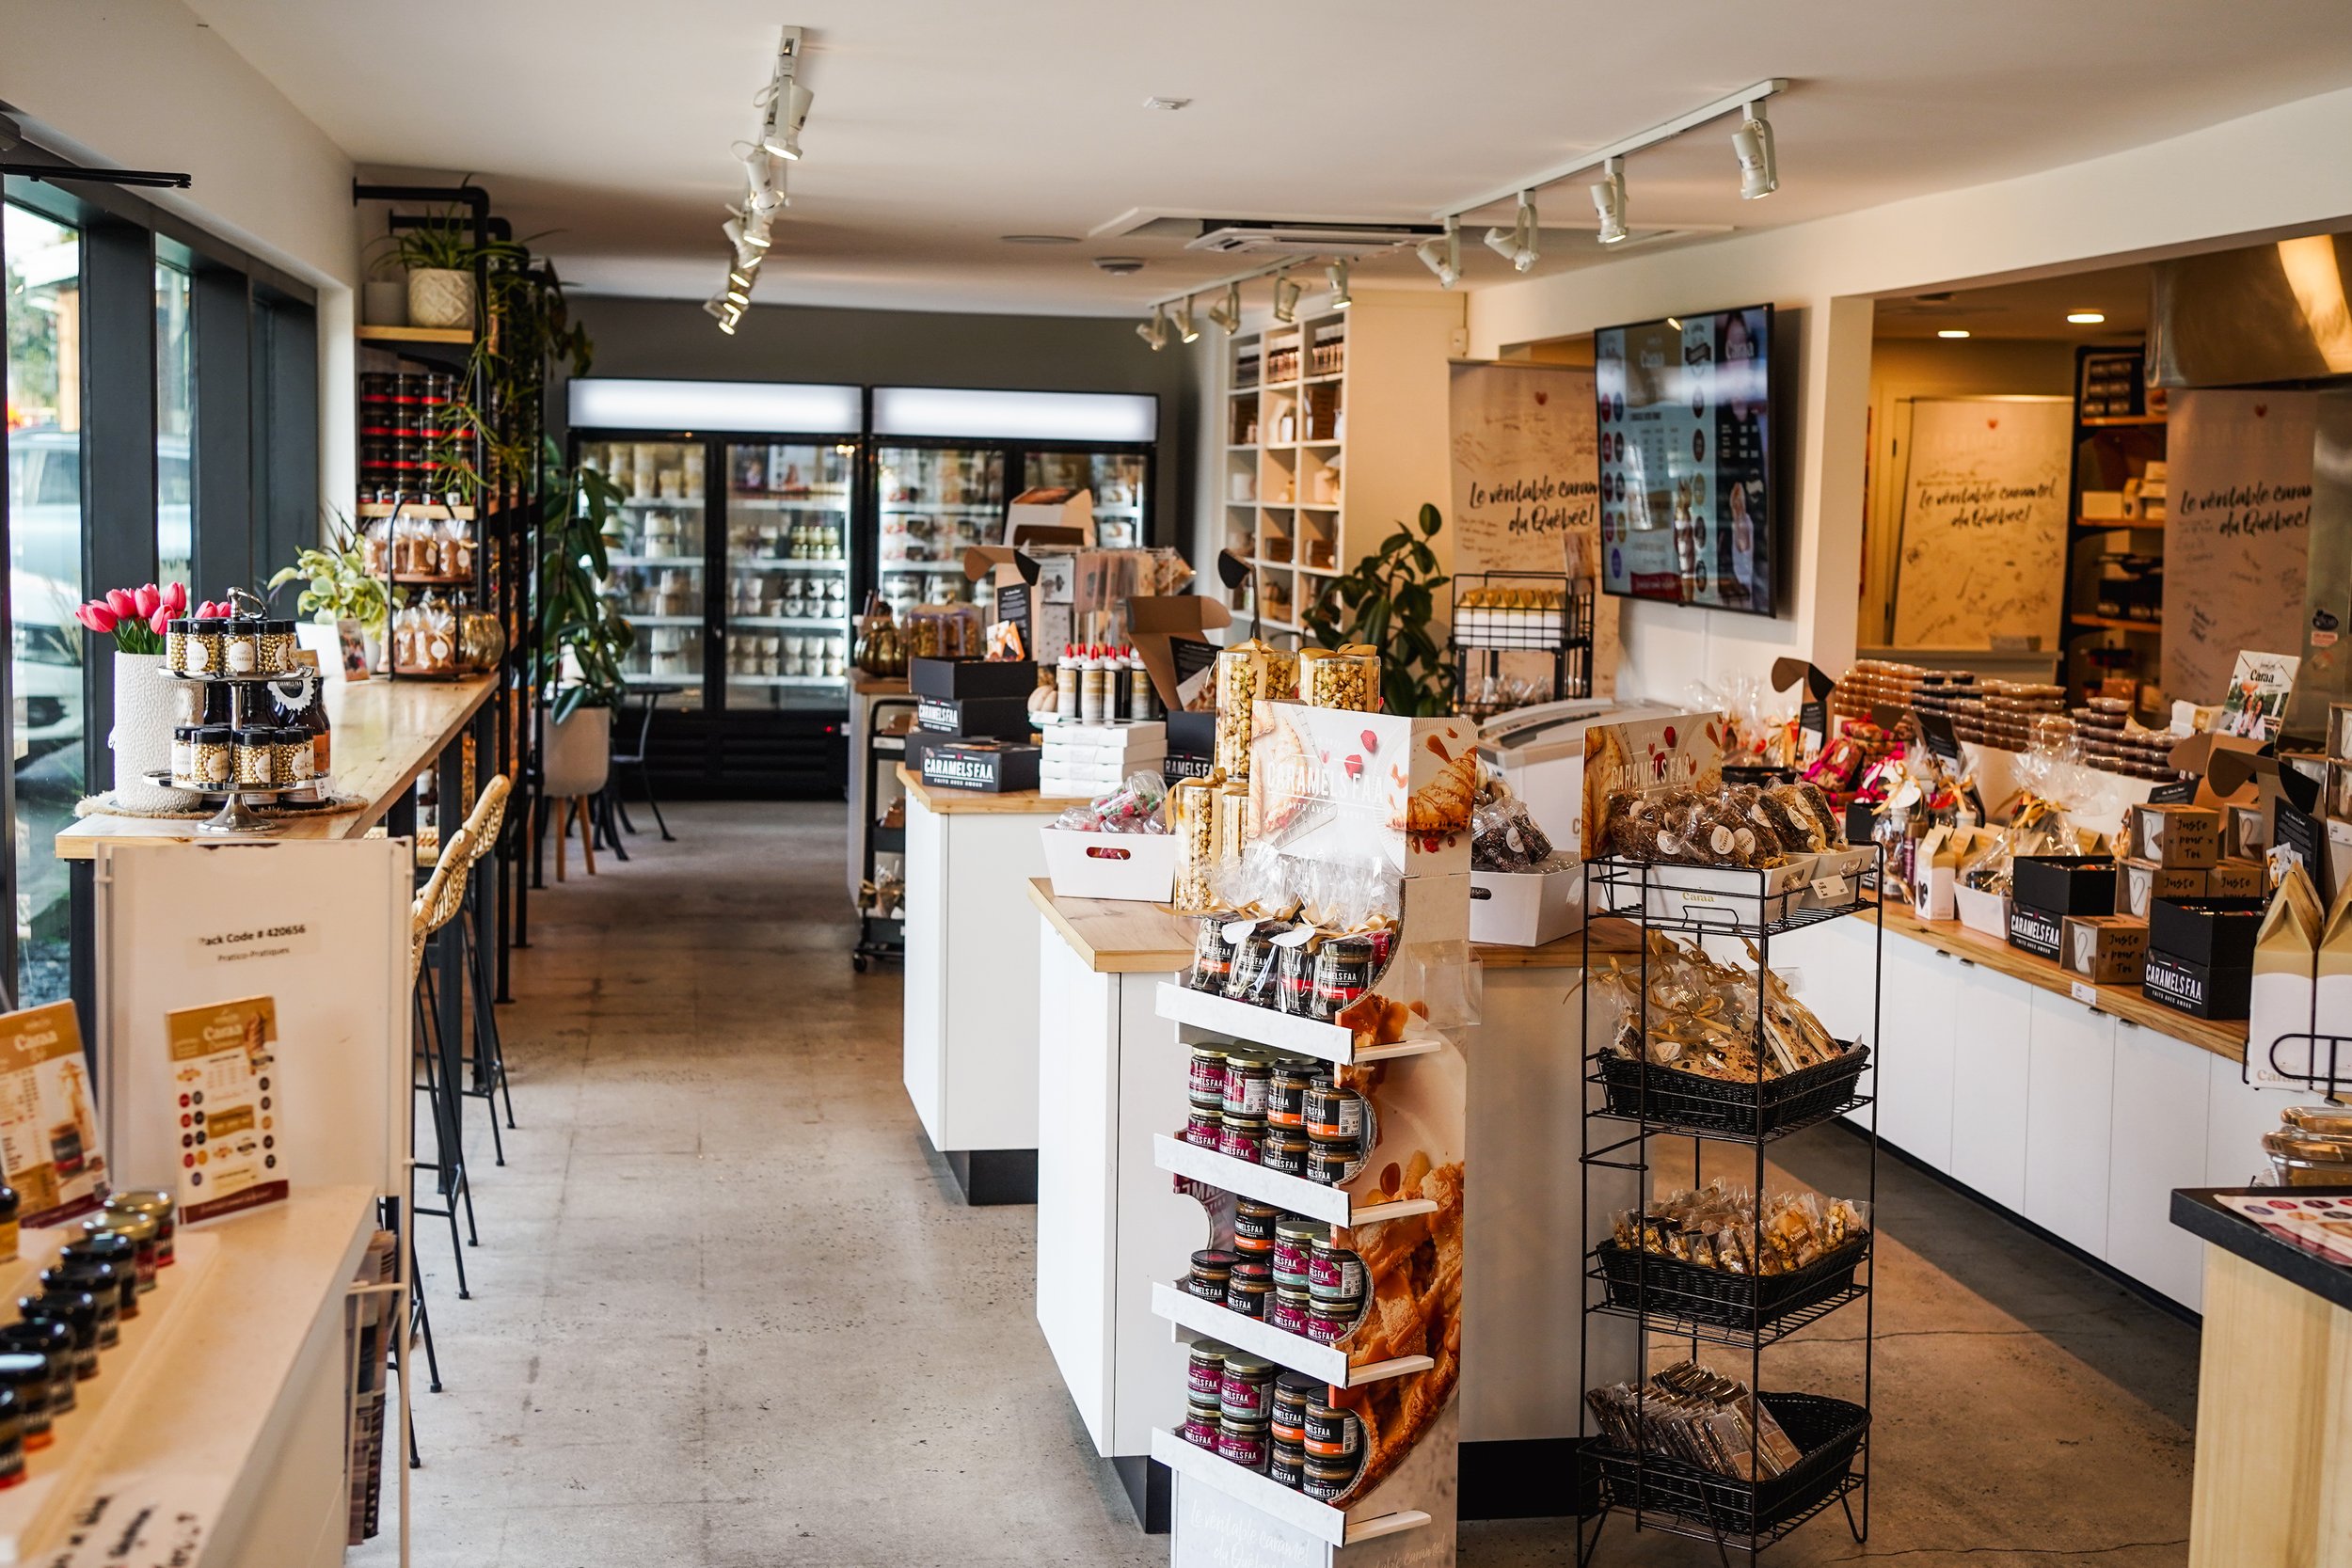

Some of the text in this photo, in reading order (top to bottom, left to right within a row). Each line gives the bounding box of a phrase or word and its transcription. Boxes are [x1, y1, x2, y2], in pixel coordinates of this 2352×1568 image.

[1470, 482, 1486, 509] Le
[1559, 481, 1597, 498] caram
[2181, 490, 2196, 515] Le
[2273, 484, 2312, 501] caram
[1509, 506, 1528, 536] du
[1951, 508, 1968, 530] du
[2220, 511, 2239, 538] du
[2249, 669, 2275, 684] Caraa
[1166, 760, 1201, 777] RAMELS
[1612, 756, 1691, 790] CARAMELS FAA
[1267, 762, 1384, 803] CARAMELS FAA
[2176, 819, 2208, 832] Juste
[2164, 878, 2195, 890] Juste
[2221, 877, 2251, 889] Juste
[1682, 892, 1715, 903] Caraa
[226, 933, 254, 943] Code
[2011, 914, 2059, 946] CARAMELS FAA
[2108, 934, 2138, 945] Juste
[2146, 964, 2202, 1000] CARAMELS FAA
[1789, 1227, 1808, 1243] Caraa
[1191, 1498, 1202, 1528] Le
[1404, 1532, 1446, 1566] caramel
